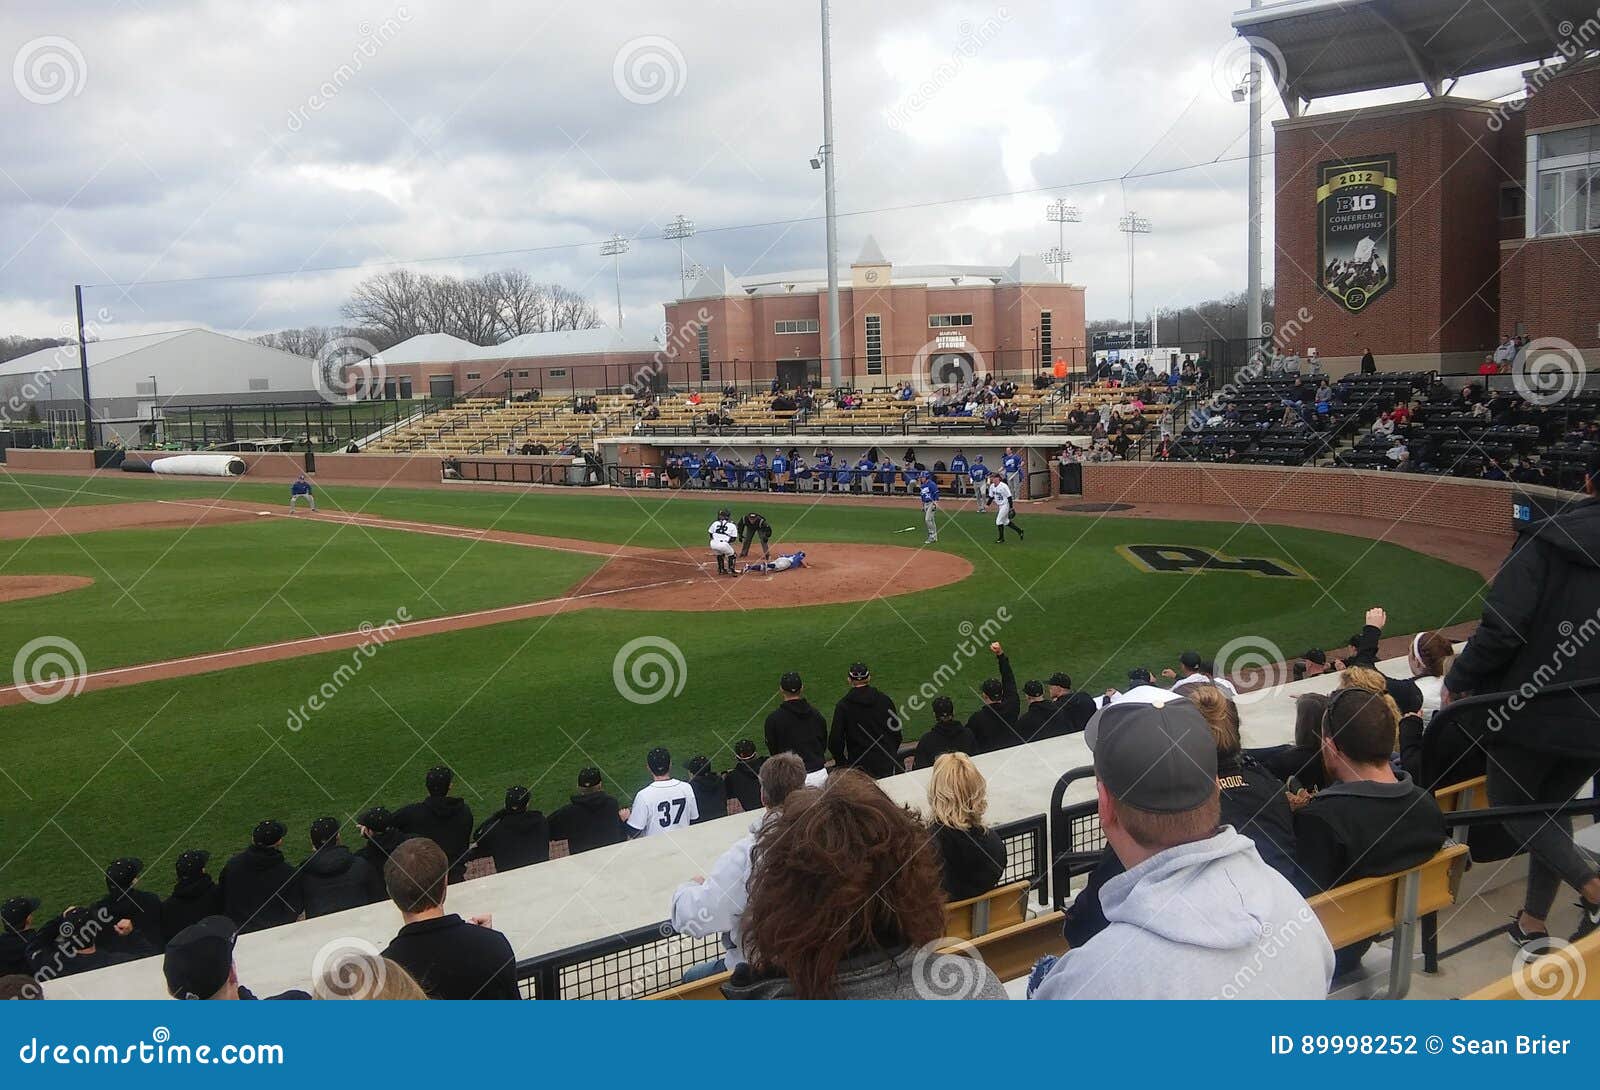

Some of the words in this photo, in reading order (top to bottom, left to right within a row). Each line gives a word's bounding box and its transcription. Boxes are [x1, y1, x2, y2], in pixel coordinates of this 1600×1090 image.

[1340, 173, 1373, 185] 2012
[1329, 211, 1385, 224] CONFERENCE
[1330, 221, 1382, 233] CHAMPIONS
[657, 797, 686, 828] 37
